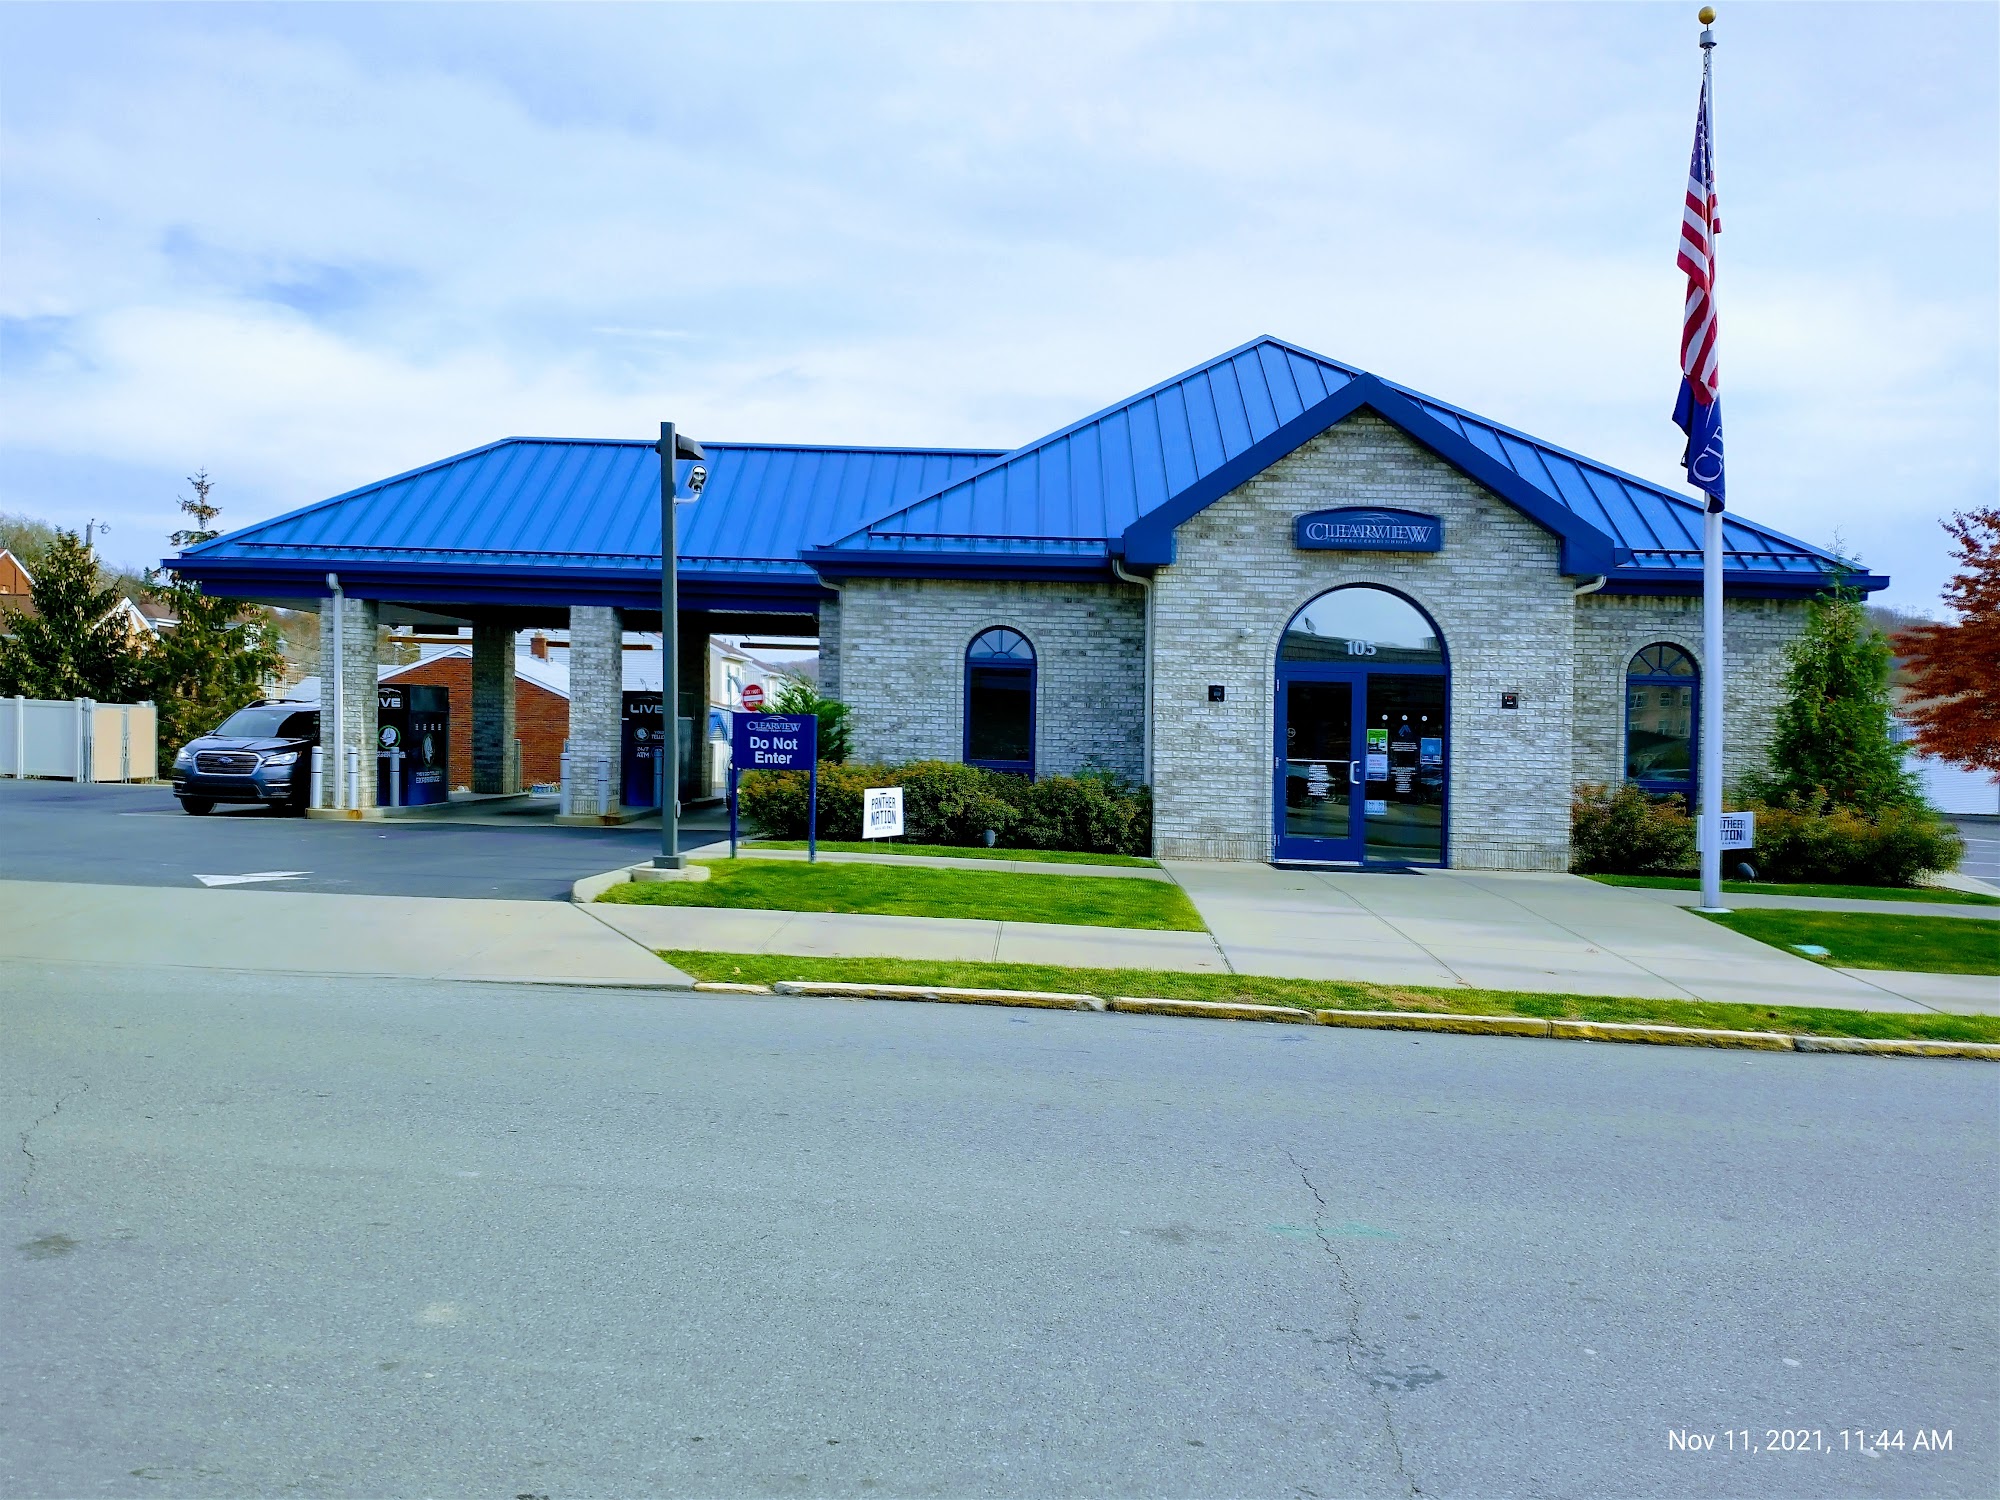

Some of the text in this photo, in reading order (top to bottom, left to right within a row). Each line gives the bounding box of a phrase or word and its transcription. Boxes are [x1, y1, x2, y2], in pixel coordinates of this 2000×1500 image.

[1306, 523, 1434, 543] CLEARVIEW
[1345, 640, 1377, 656] 105
[630, 704, 664, 714] LIVE
[746, 721, 801, 732] CLEARVIEW
[750, 737, 798, 750] Do Not
[754, 752, 793, 764] Enter
[871, 797, 896, 810] PANTHER
[870, 810, 897, 826] NATION
